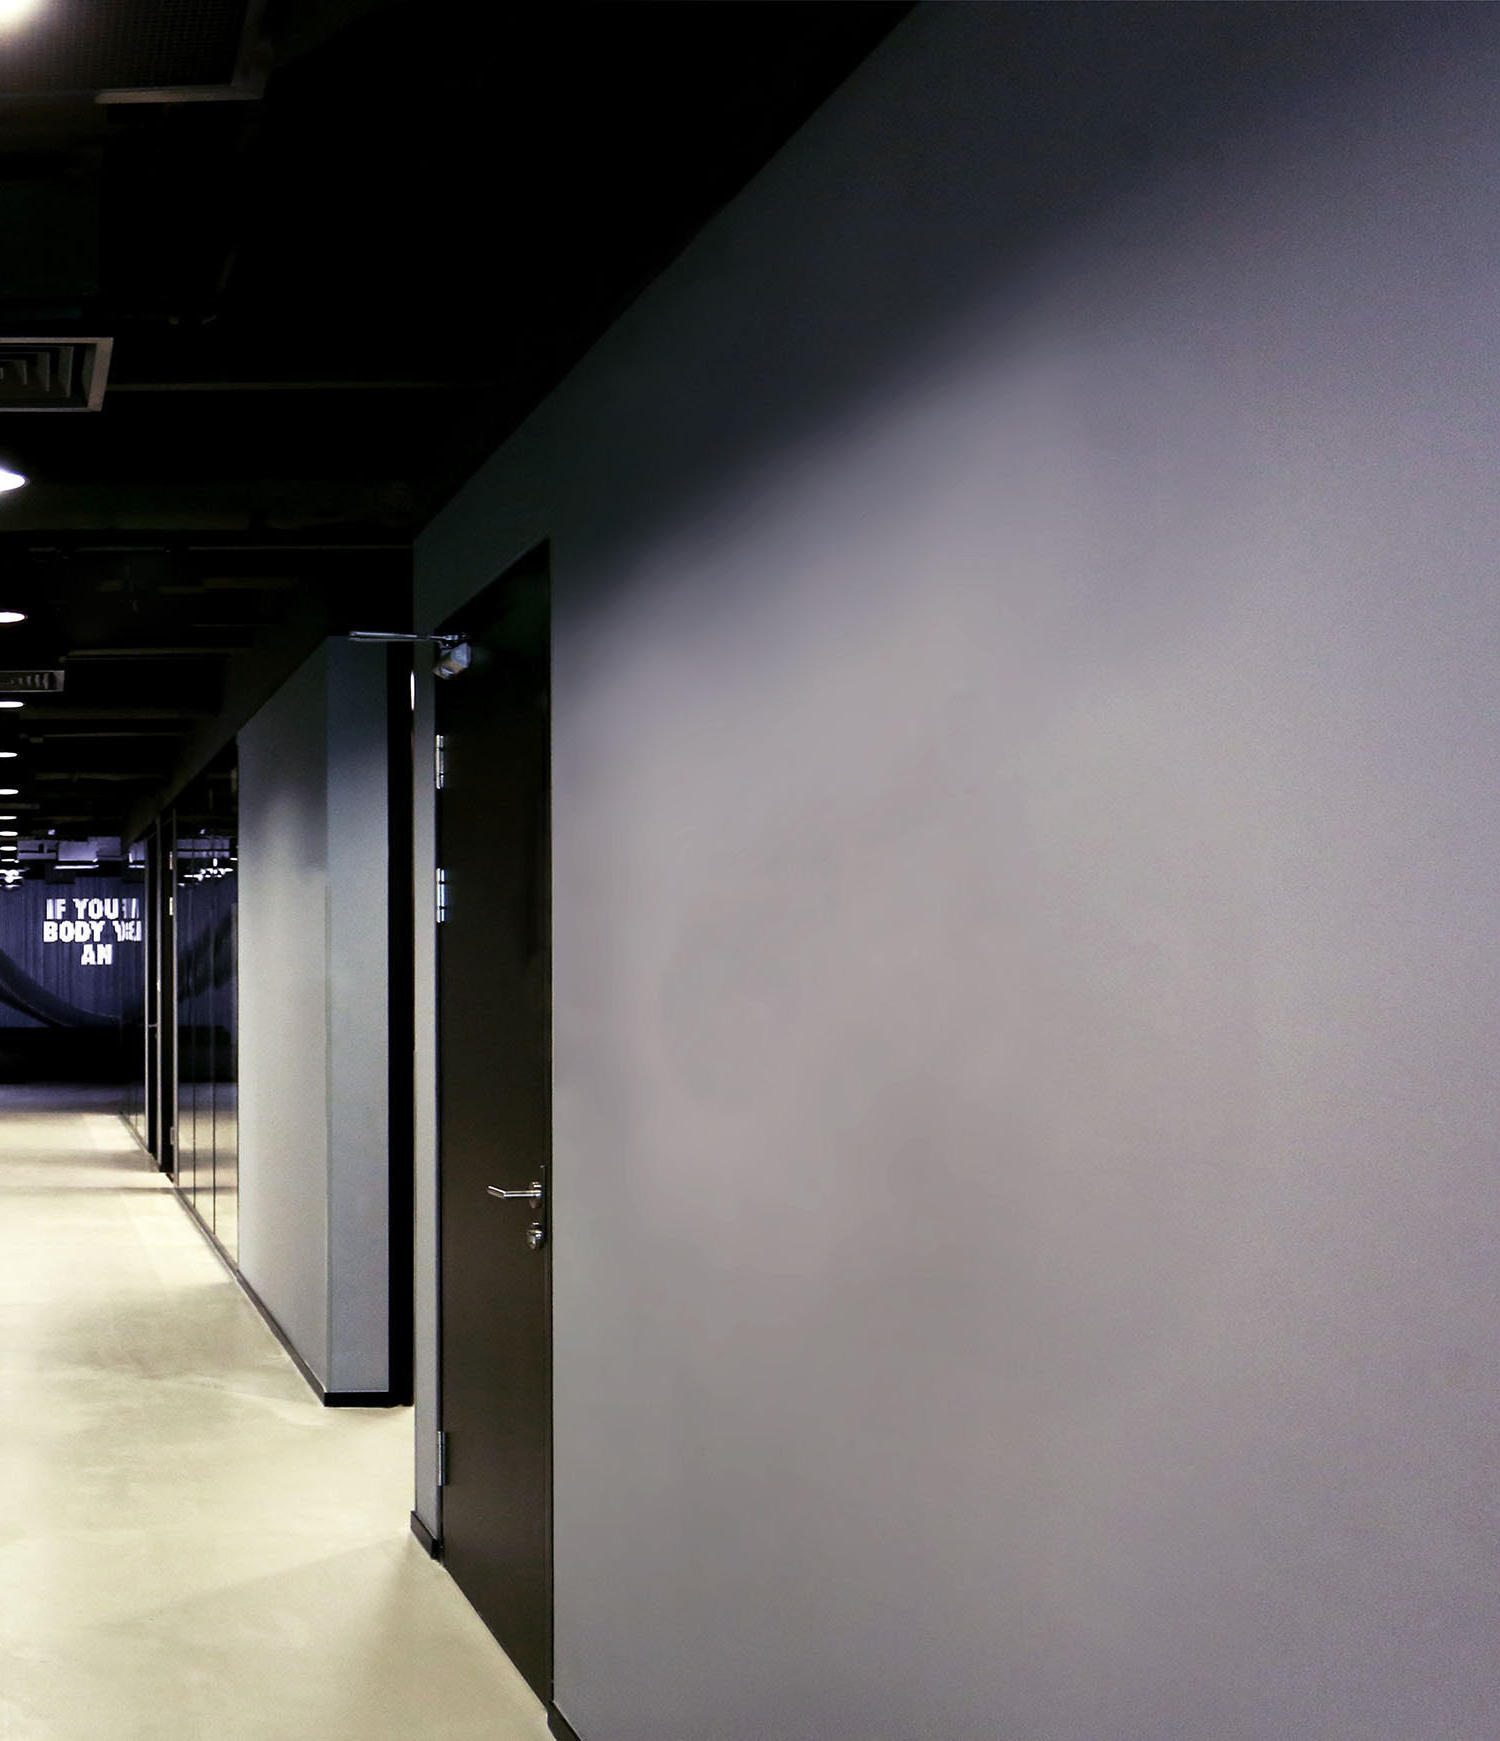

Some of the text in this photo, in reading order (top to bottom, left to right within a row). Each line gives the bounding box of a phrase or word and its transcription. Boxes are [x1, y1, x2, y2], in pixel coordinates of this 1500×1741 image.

[46, 898, 66, 920] IF
[72, 898, 119, 920] YOU
[43, 920, 106, 942] BODY
[80, 943, 113, 965] AN
